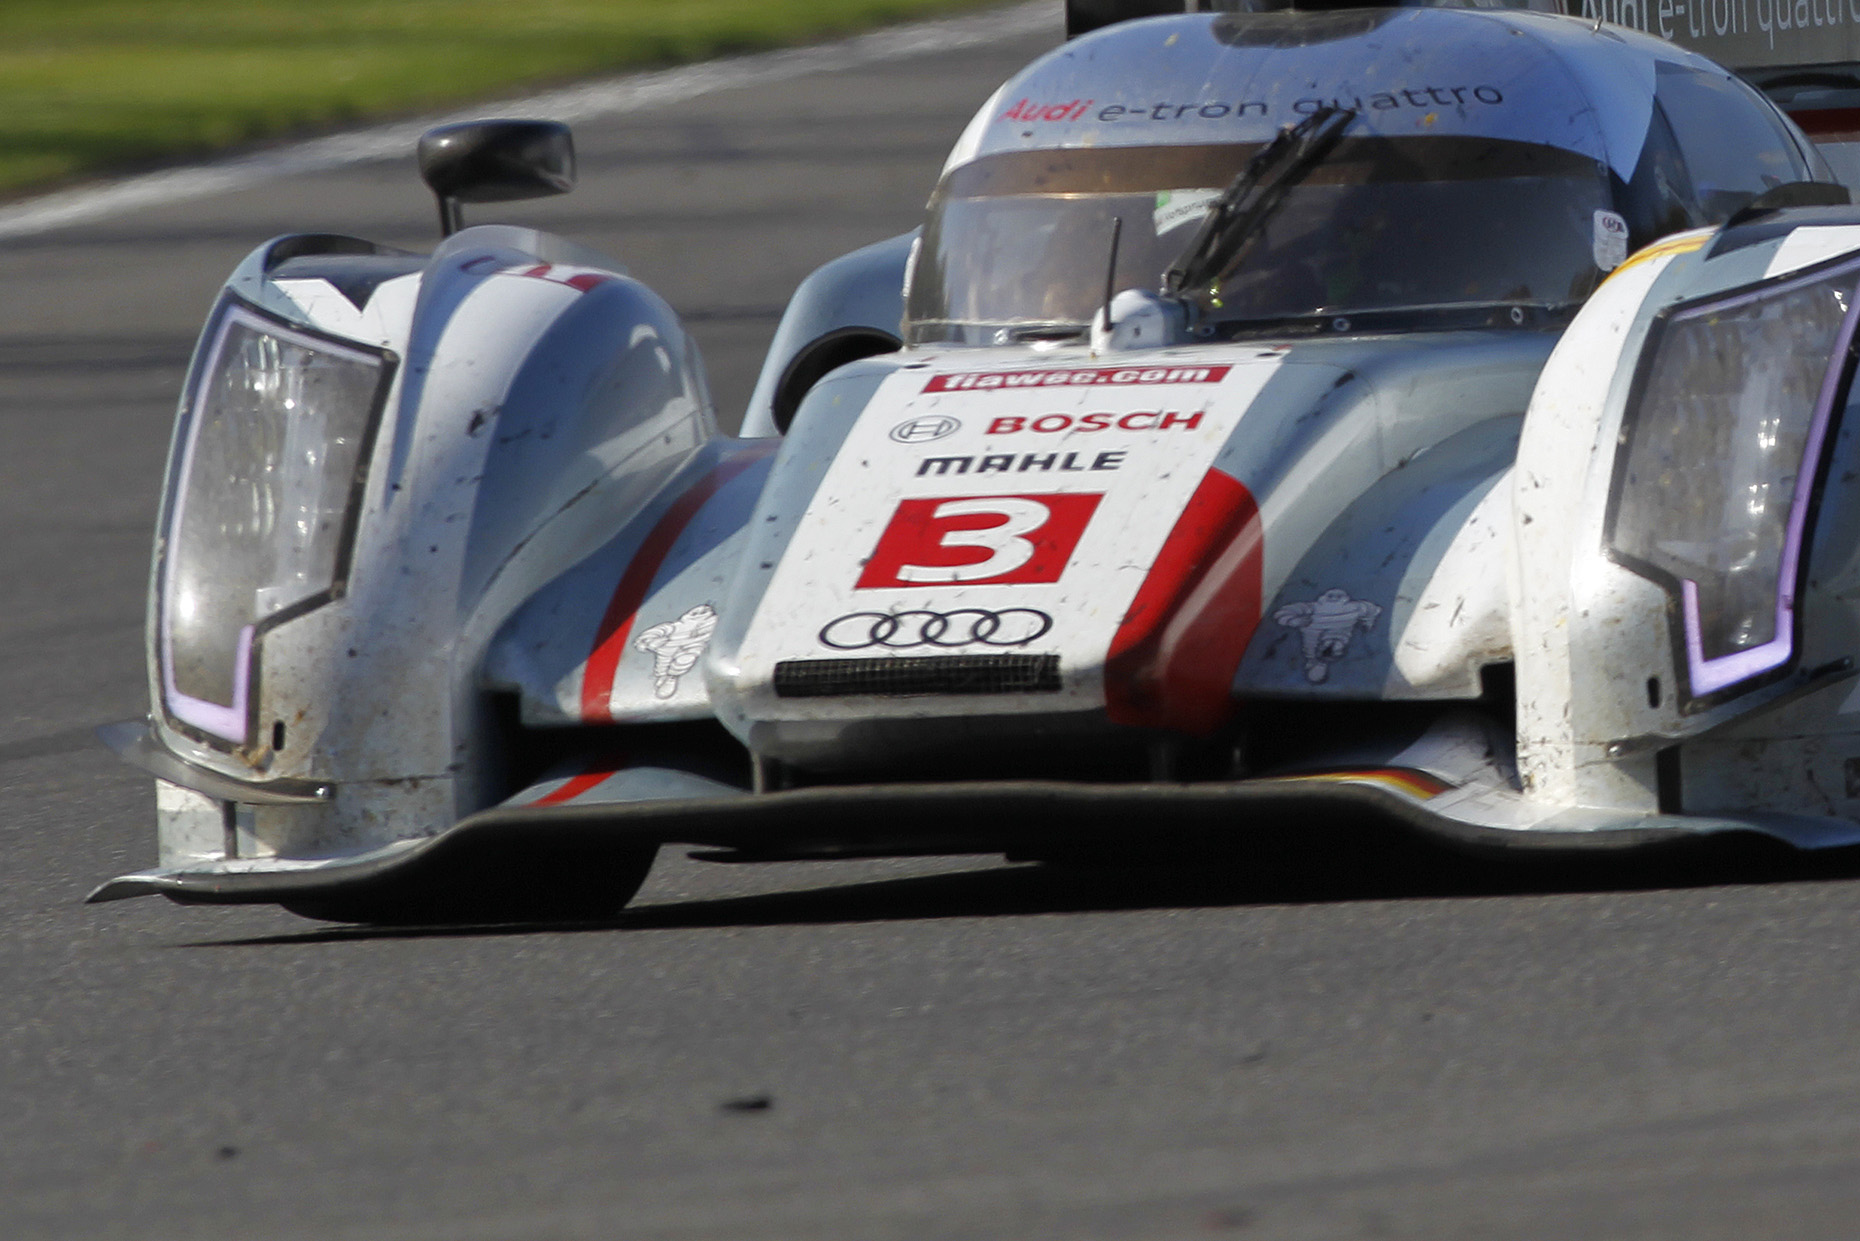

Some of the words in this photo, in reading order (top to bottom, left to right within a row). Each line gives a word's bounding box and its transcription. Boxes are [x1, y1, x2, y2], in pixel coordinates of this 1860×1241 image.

[1000, 97, 1094, 123] Audi
[1097, 96, 1269, 123] e-tron
[1293, 82, 1504, 120] quattro
[944, 367, 1209, 389] fiawec.com
[985, 410, 1205, 435] BOSCH
[915, 450, 1128, 477] MAHLE
[896, 497, 1050, 583] 3
